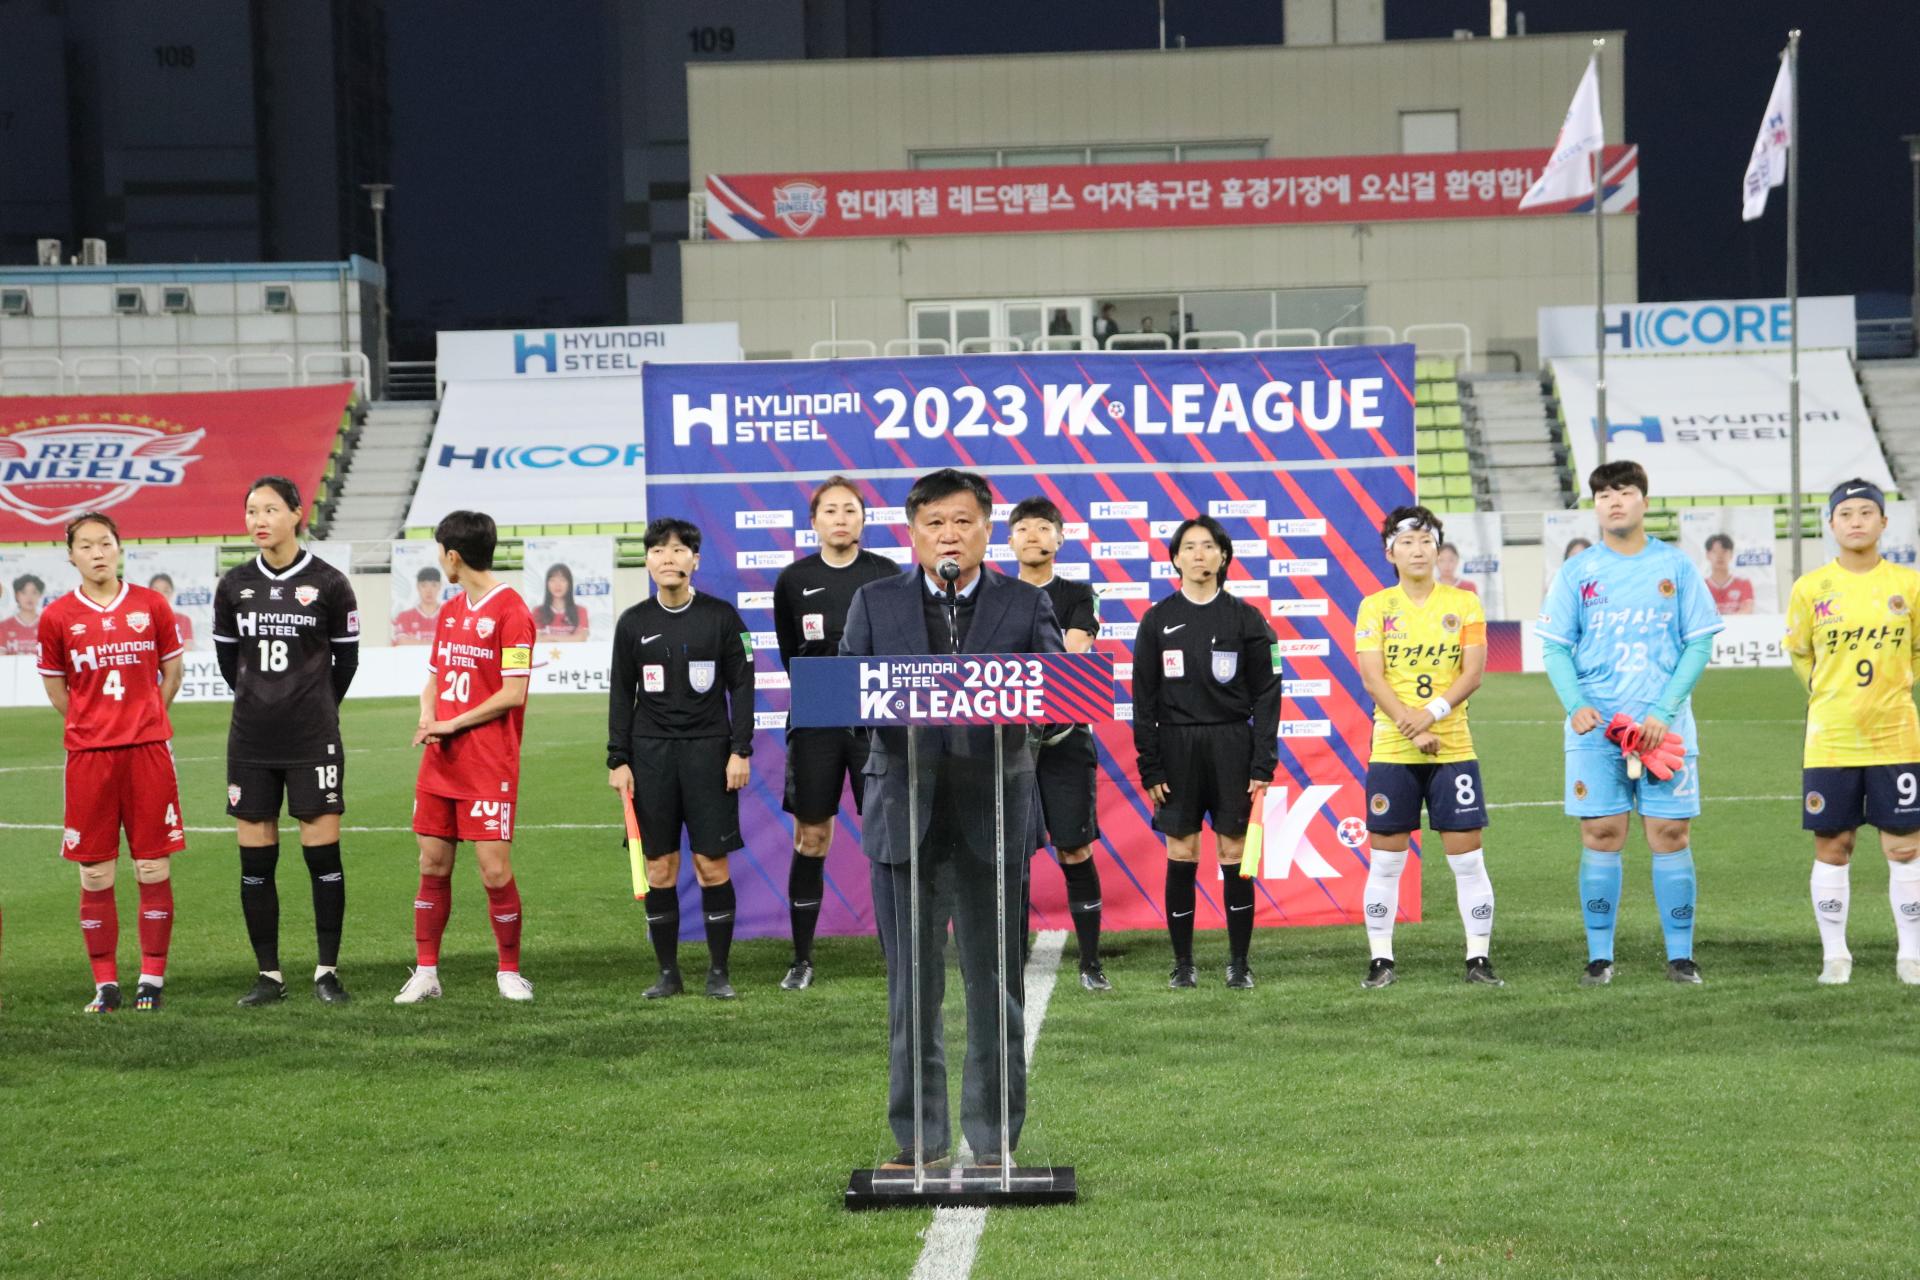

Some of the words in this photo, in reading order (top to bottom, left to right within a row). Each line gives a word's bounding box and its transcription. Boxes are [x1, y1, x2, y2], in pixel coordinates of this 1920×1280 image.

[688, 26, 735, 53] 109
[155, 45, 195, 68] 108
[836, 187, 938, 220] 현대제철
[947, 183, 1075, 218] 레드엔젤스
[1082, 179, 1211, 213] 여자축구단
[1221, 175, 1351, 209] 홈경기장에
[1359, 171, 1437, 202] 오신걸
[1444, 167, 1534, 201] 환영합
[1654, 305, 1793, 346] CORE
[564, 331, 666, 349] HYUNDAI
[564, 353, 639, 370] STEEL
[735, 393, 860, 416] HYUNDAI
[874, 385, 1028, 439] 2023
[1133, 377, 1385, 434] LEAGUE
[1672, 410, 1840, 425] HYUNDAI
[736, 418, 827, 442] STEEL
[1676, 427, 1791, 442] STEEL
[38, 443, 124, 458] RED
[0, 459, 176, 483] NGELS
[258, 612, 317, 627] HYUNDAI
[258, 625, 300, 637] STEEL
[97, 640, 155, 656] HYUNDAI
[257, 639, 289, 672] 18
[452, 643, 494, 660] HYUNDAI
[1614, 641, 1649, 673] 23
[98, 653, 142, 668] STEEL
[892, 662, 957, 675] HYUNDAI
[102, 669, 126, 701] 4
[892, 675, 940, 688] STEEL
[963, 660, 1044, 688] 2023
[1856, 659, 1874, 687] 9
[440, 670, 471, 704] 20
[1416, 673, 1433, 699] 8
[909, 688, 1045, 718] LEAGUE
[314, 764, 338, 789] 18
[1454, 773, 1476, 805] 8
[1896, 772, 1917, 806] 9
[165, 803, 178, 827] 4
